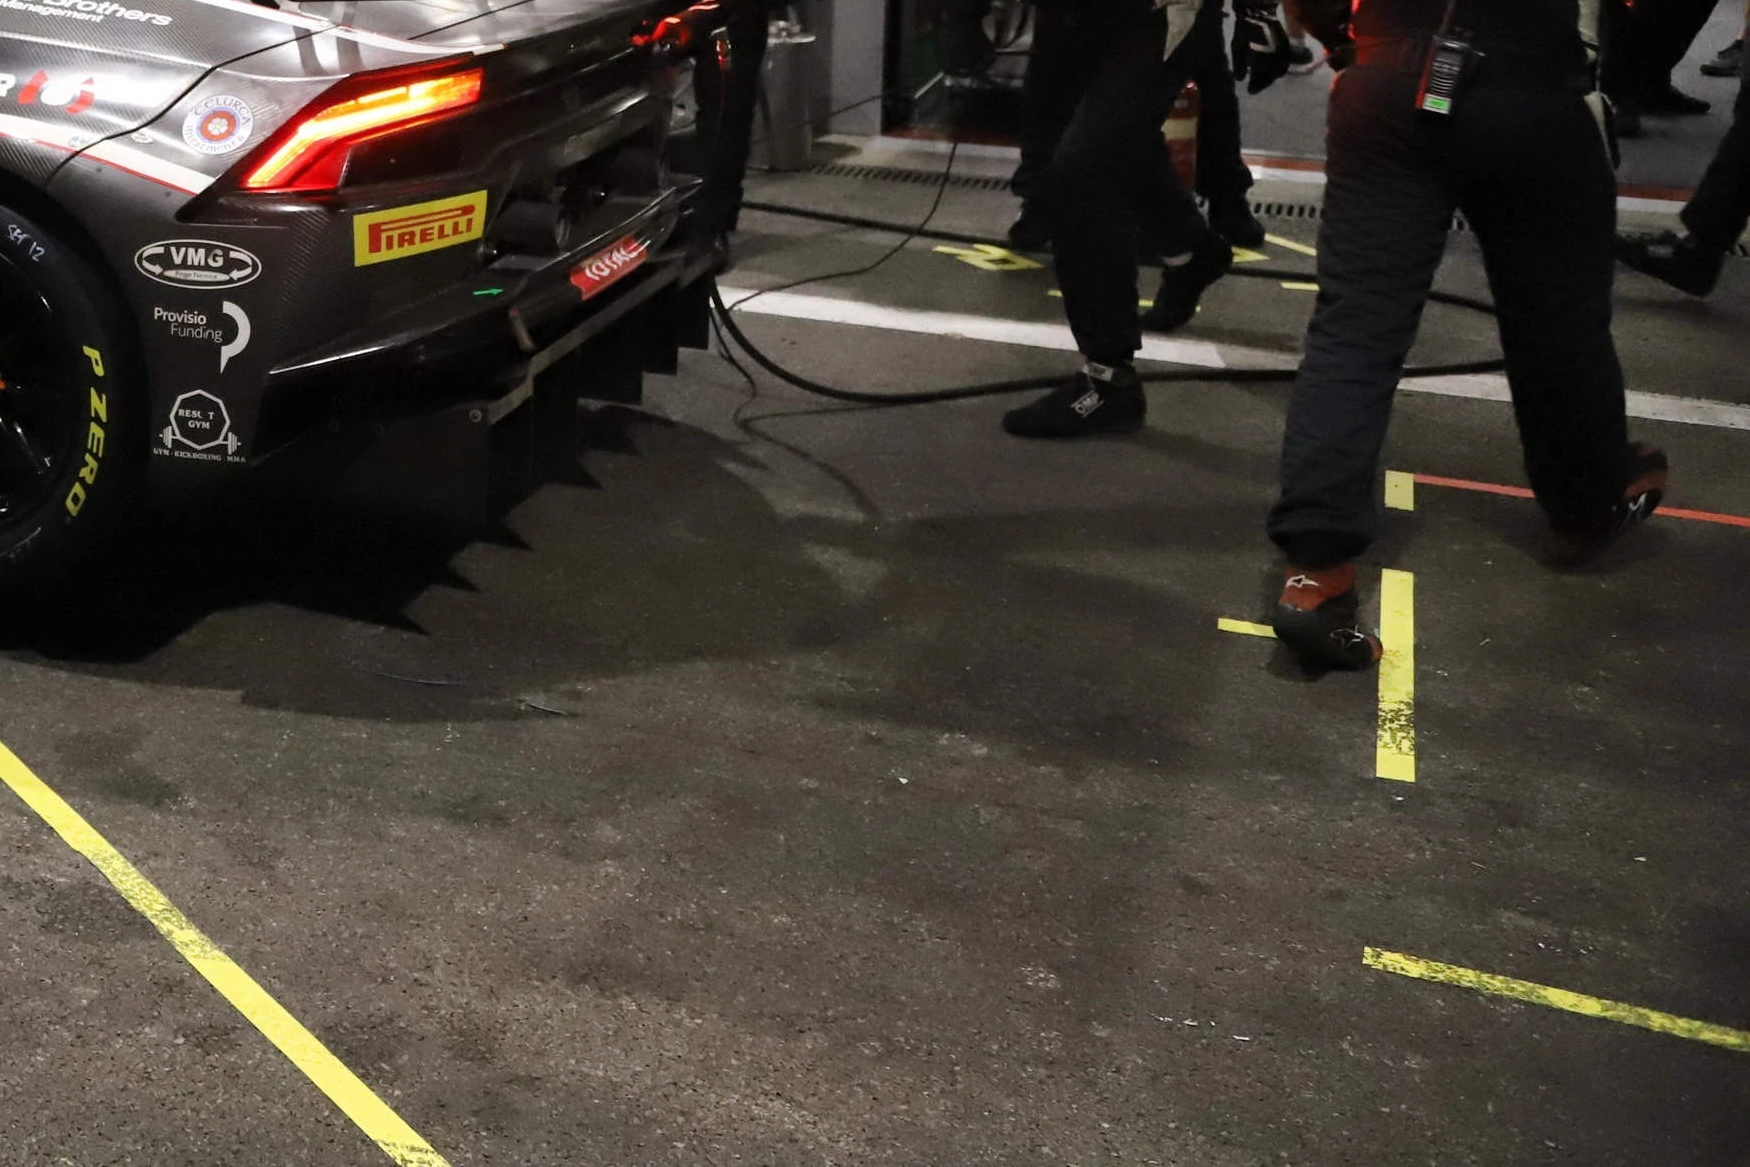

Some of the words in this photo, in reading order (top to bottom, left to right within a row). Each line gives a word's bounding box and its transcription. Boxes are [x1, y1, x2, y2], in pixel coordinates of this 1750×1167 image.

[367, 204, 477, 254] PIRELLI
[169, 246, 225, 268] VMG
[153, 307, 207, 326] Provisio
[170, 323, 223, 344] Funding
[82, 345, 105, 378] P
[1074, 392, 1099, 415] OMP
[187, 420, 211, 430] GYM
[65, 387, 108, 517] ZERO
[153, 448, 170, 458] GYM
[174, 450, 222, 462] KICKBOXING
[226, 454, 246, 464] MMA
